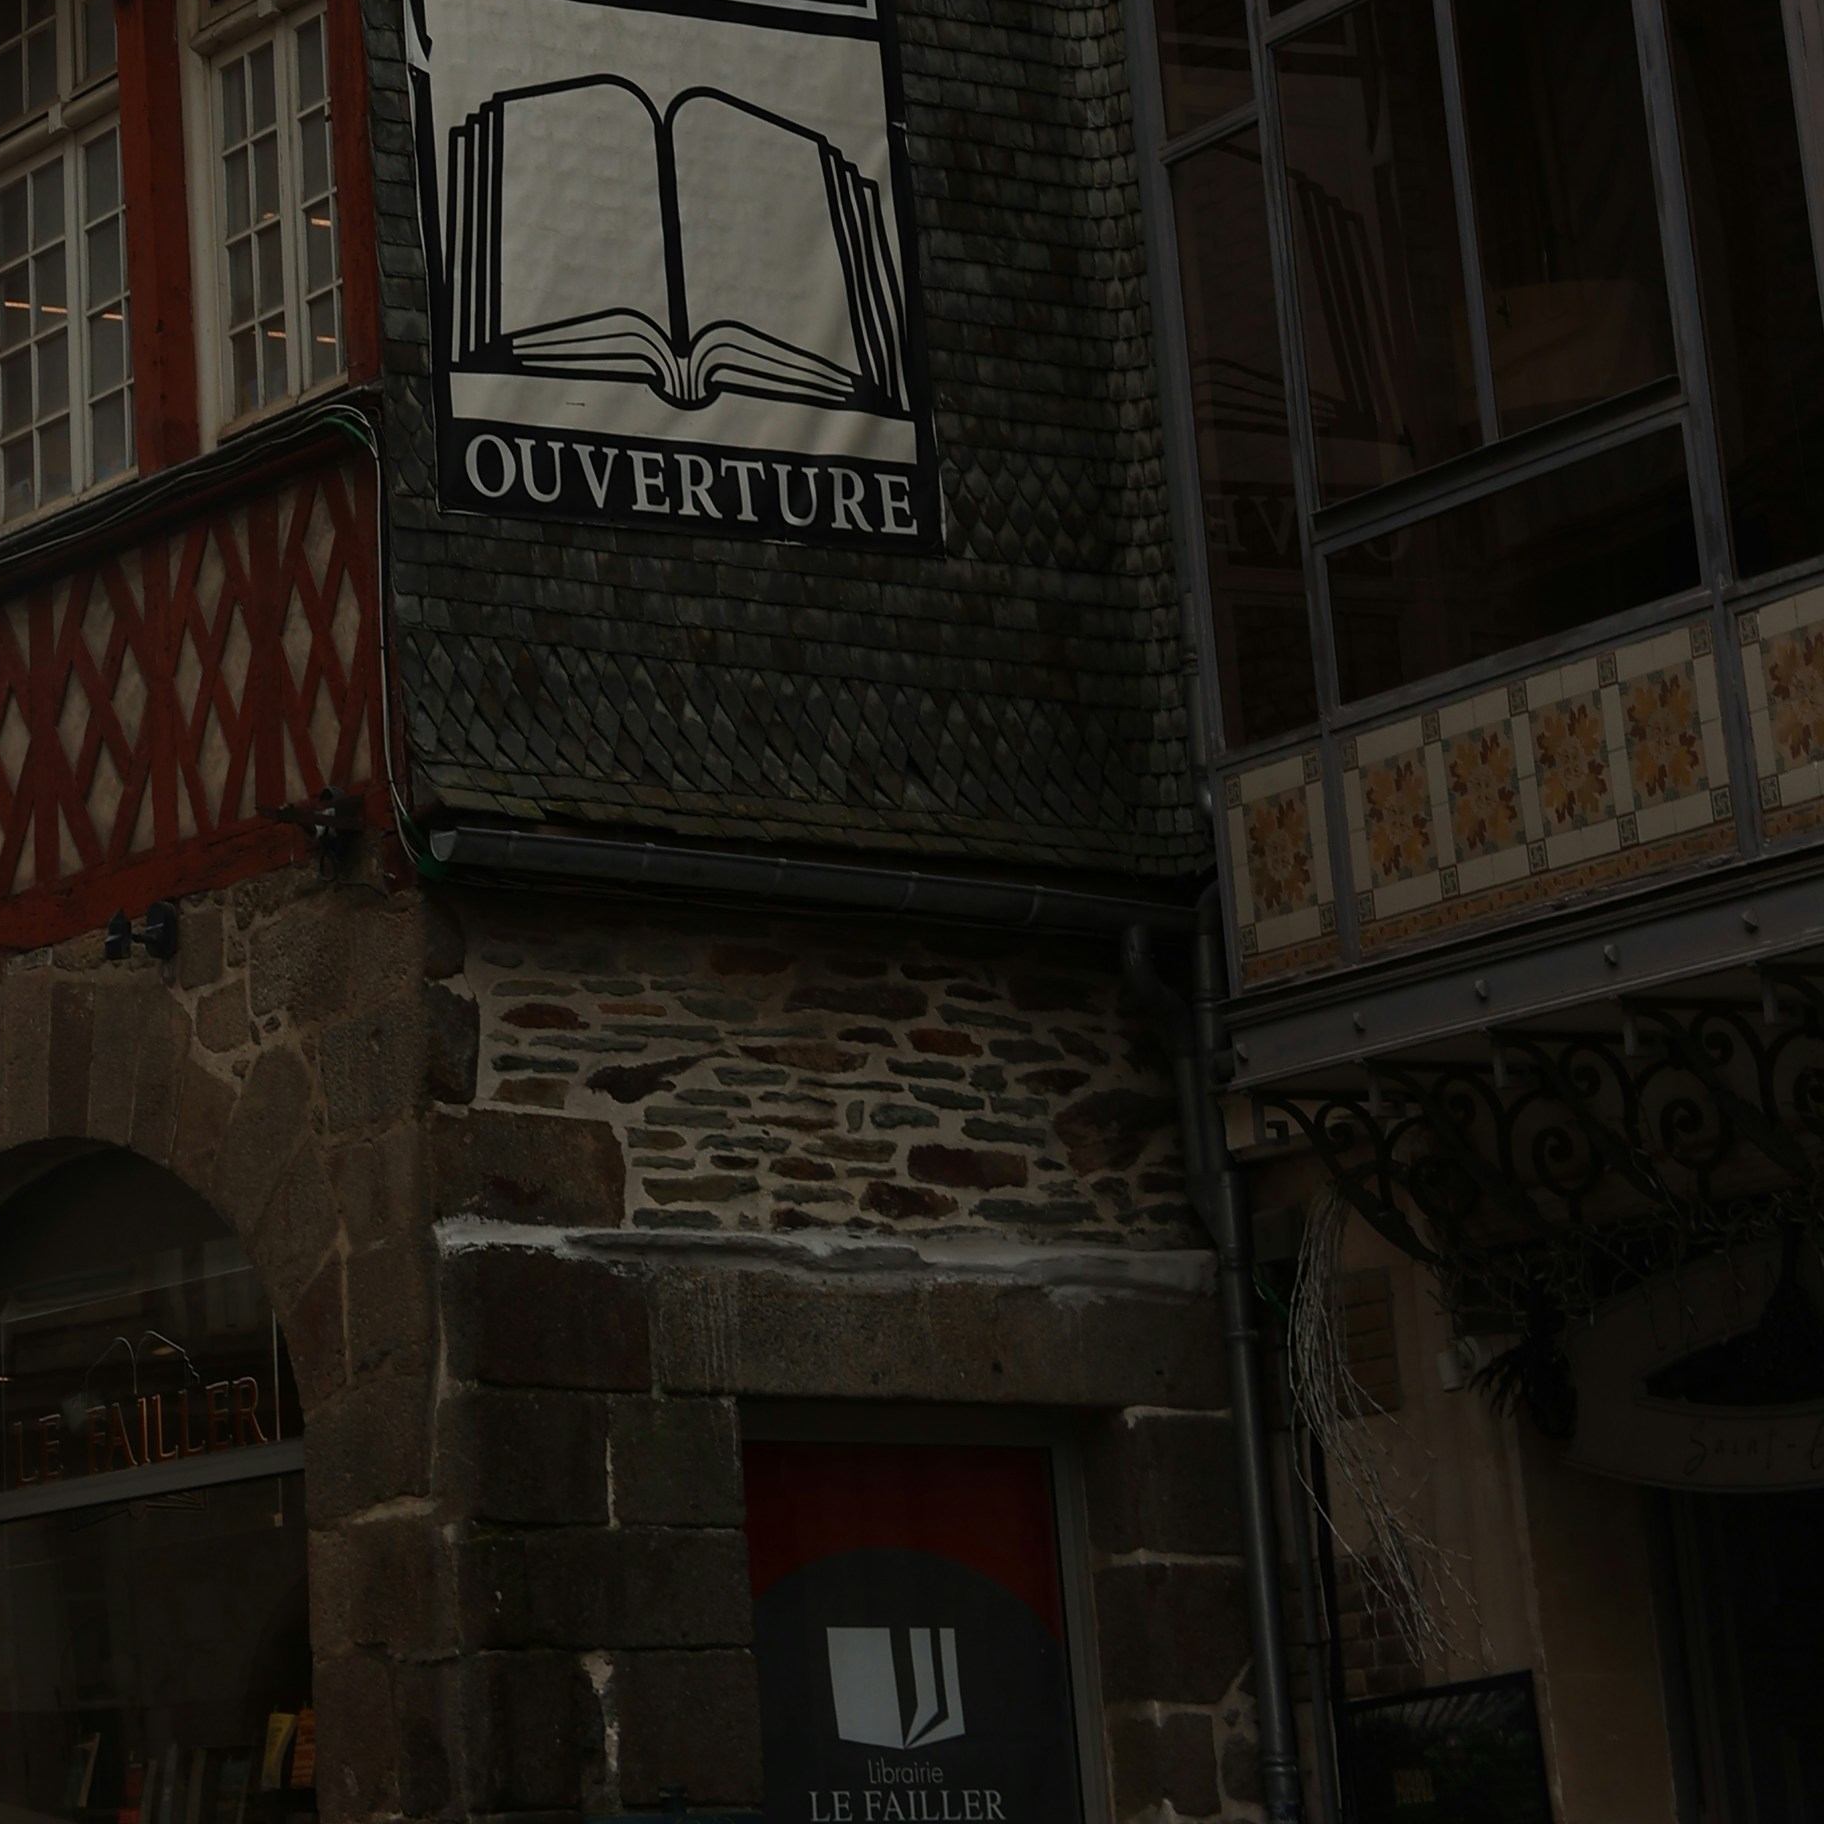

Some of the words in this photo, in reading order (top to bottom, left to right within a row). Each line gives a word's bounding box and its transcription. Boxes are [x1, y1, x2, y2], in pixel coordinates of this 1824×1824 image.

[463, 432, 919, 537] OUVERTURE
[13, 1412, 65, 1487] LE
[85, 1375, 269, 1476] FAILLER
[808, 1789, 854, 1823] LE
[862, 1788, 1008, 1822] FAILLER
[867, 1756, 945, 1785] Librairie
